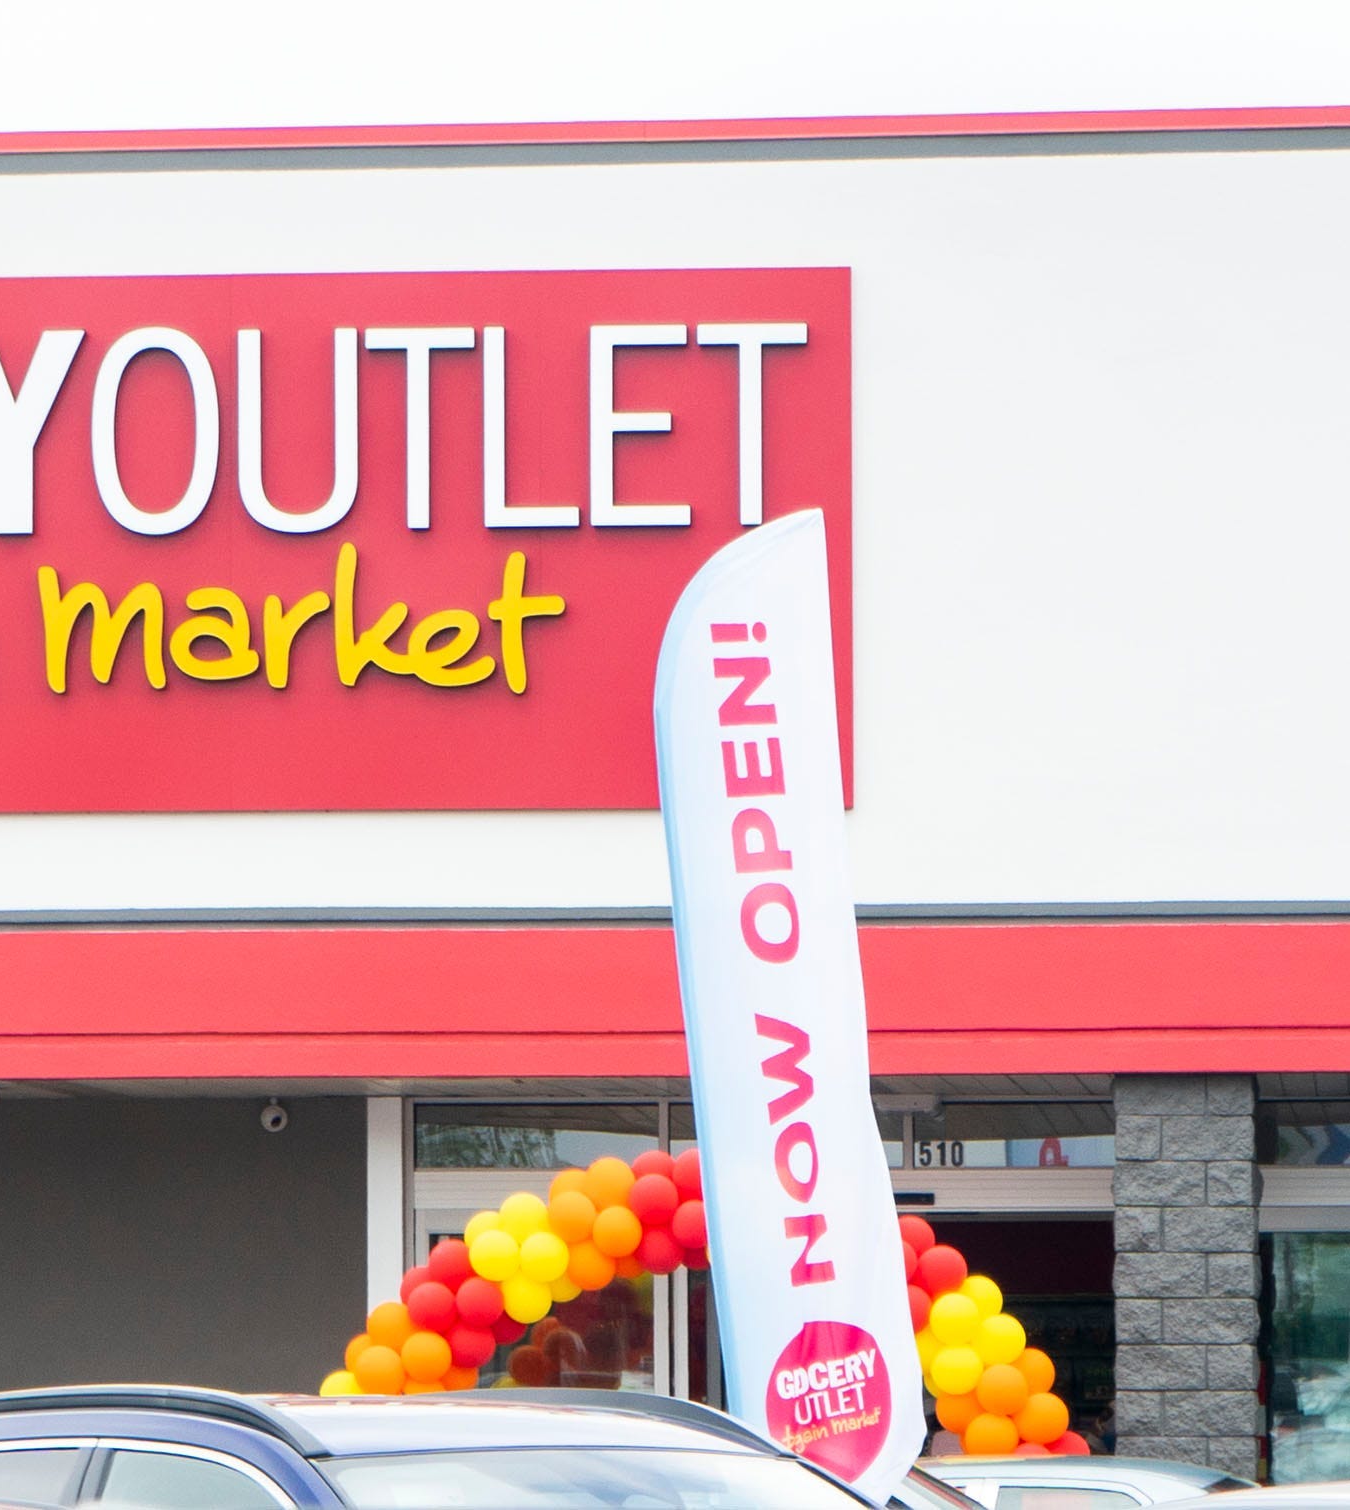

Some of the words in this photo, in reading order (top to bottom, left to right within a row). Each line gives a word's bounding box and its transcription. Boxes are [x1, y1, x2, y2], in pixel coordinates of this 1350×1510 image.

[91, 321, 808, 536] OUTLET
[37, 542, 566, 695] market
[709, 620, 800, 965] OPEN!
[754, 1012, 836, 1288] NOW
[918, 1140, 965, 1167] 510
[794, 1381, 867, 1426] UTLET
